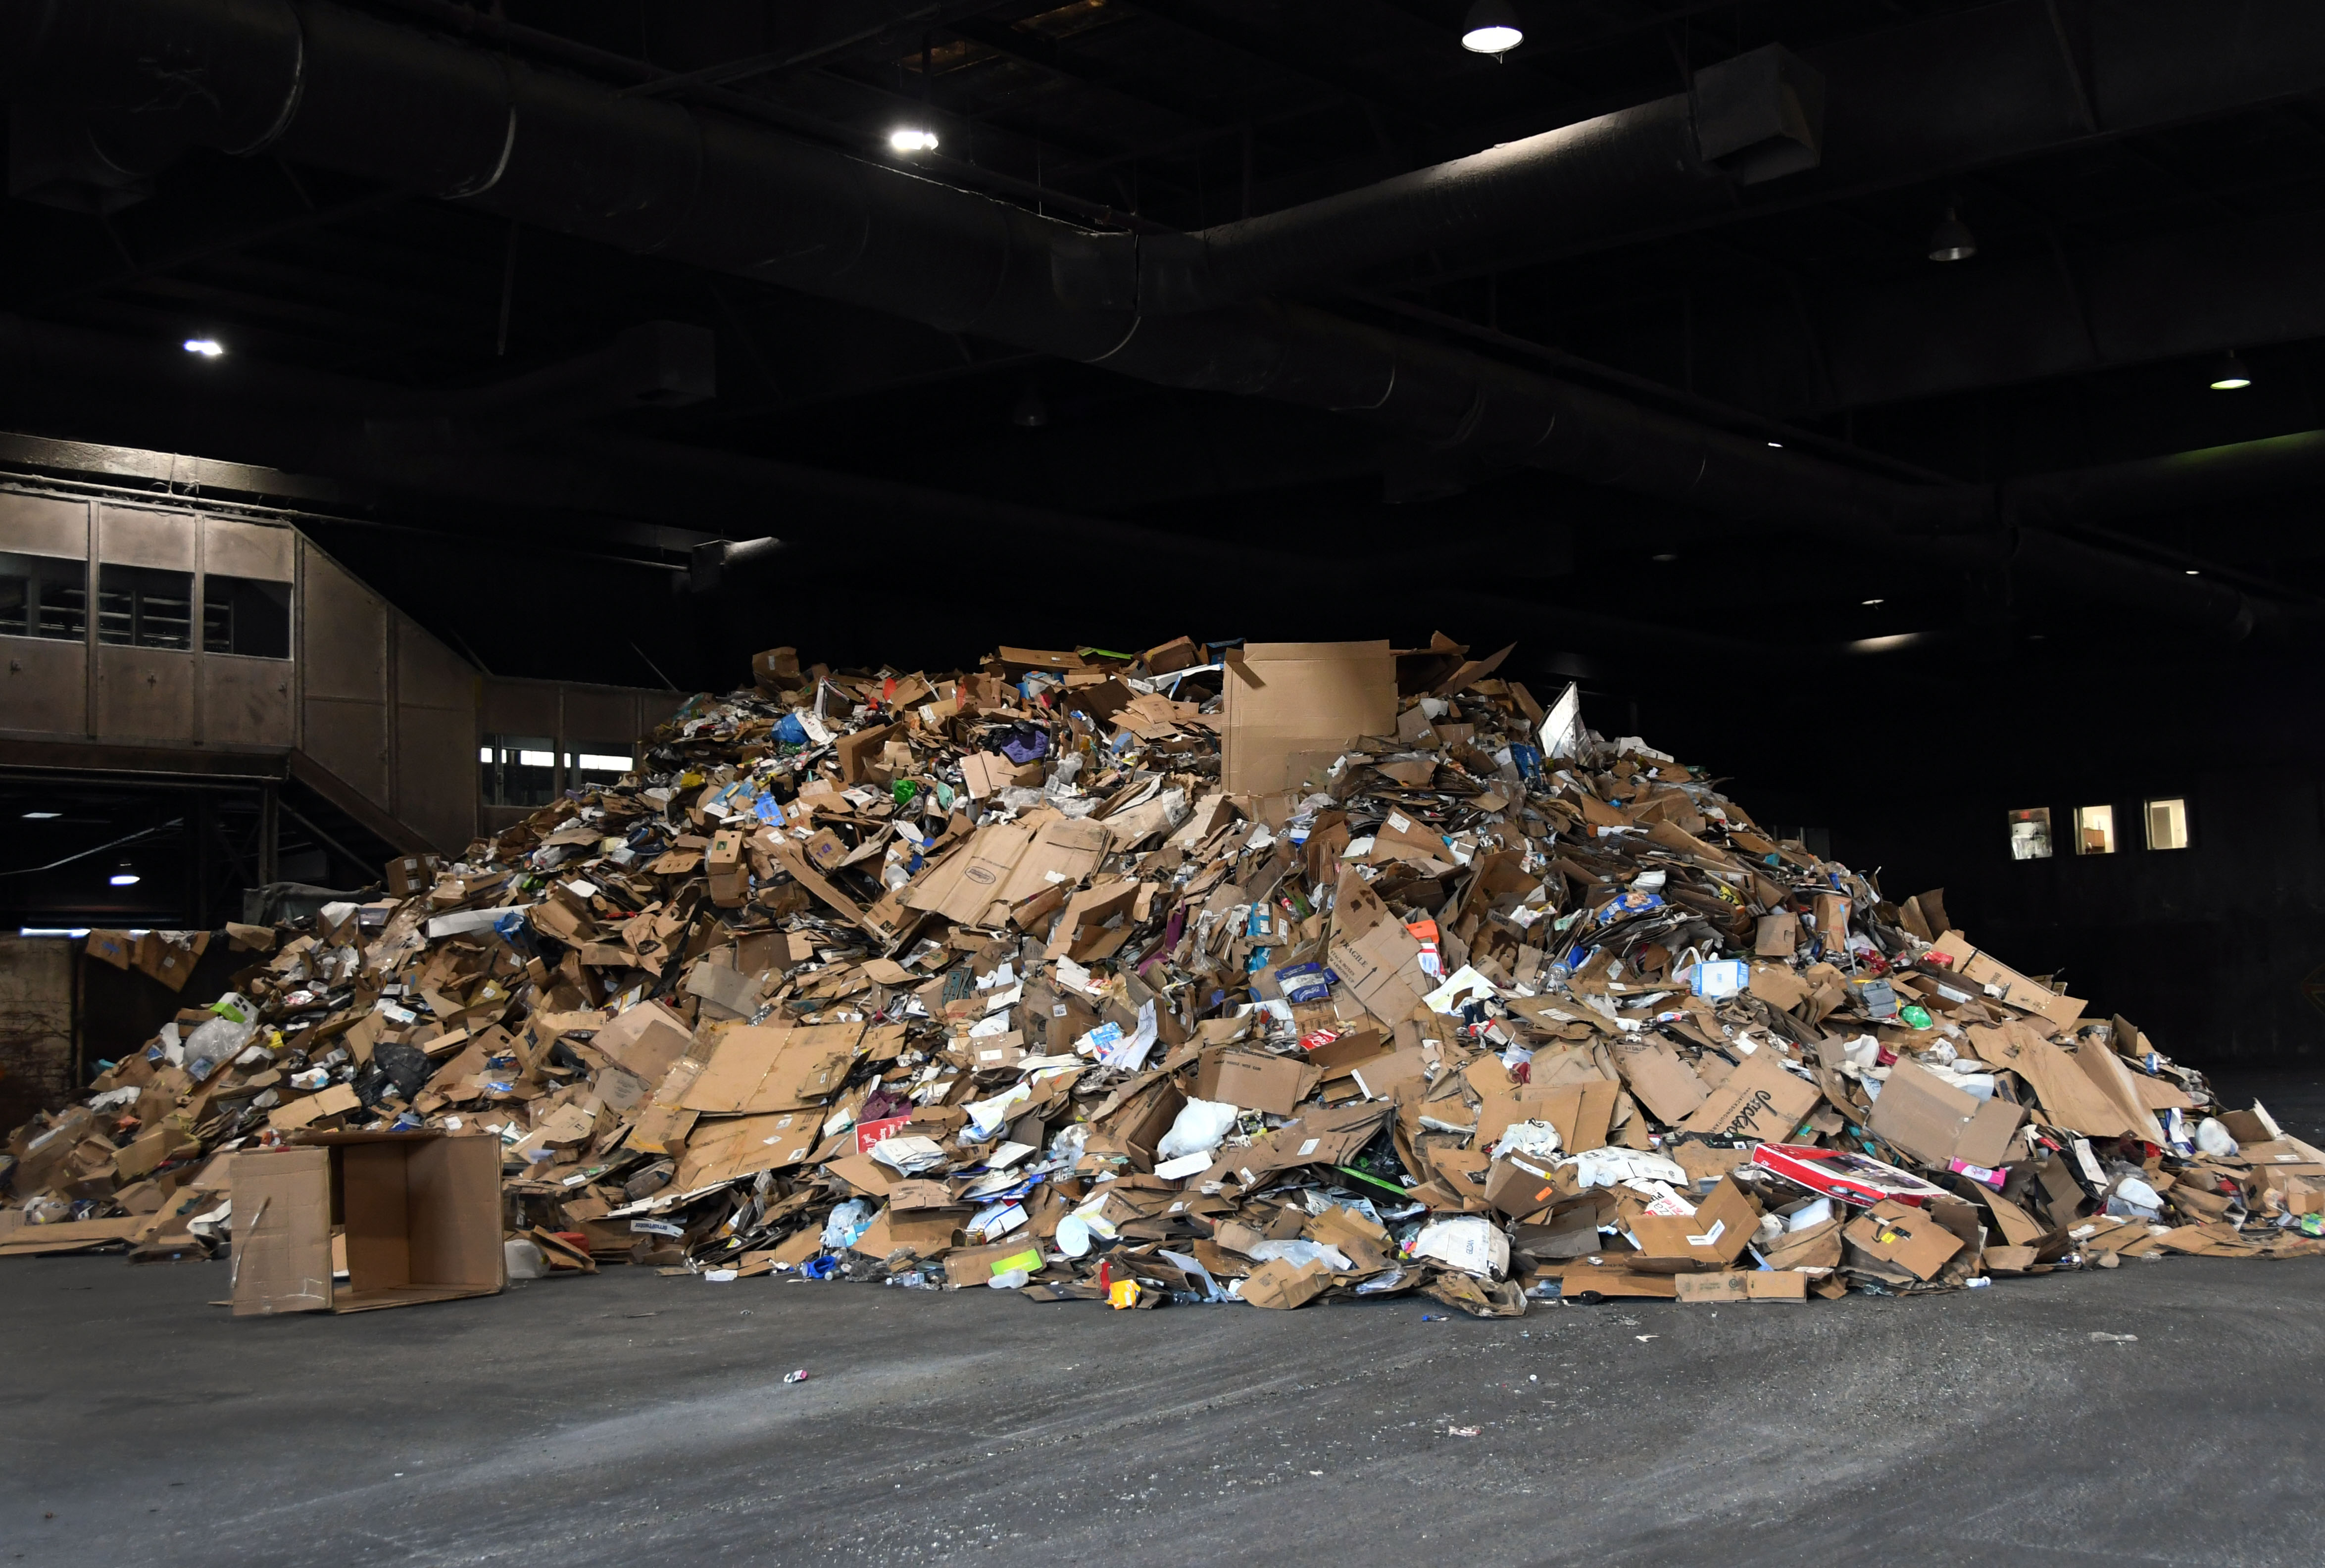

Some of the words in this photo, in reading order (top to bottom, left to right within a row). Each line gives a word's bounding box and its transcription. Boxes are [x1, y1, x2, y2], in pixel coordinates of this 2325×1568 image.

[1331, 950, 1342, 964] STACK
[1342, 962, 1355, 976] BOXES
[1340, 939, 1368, 968] FRAGILE
[1661, 1198, 1689, 1216] PIZ
[1466, 1239, 1474, 1255] GILDAN
